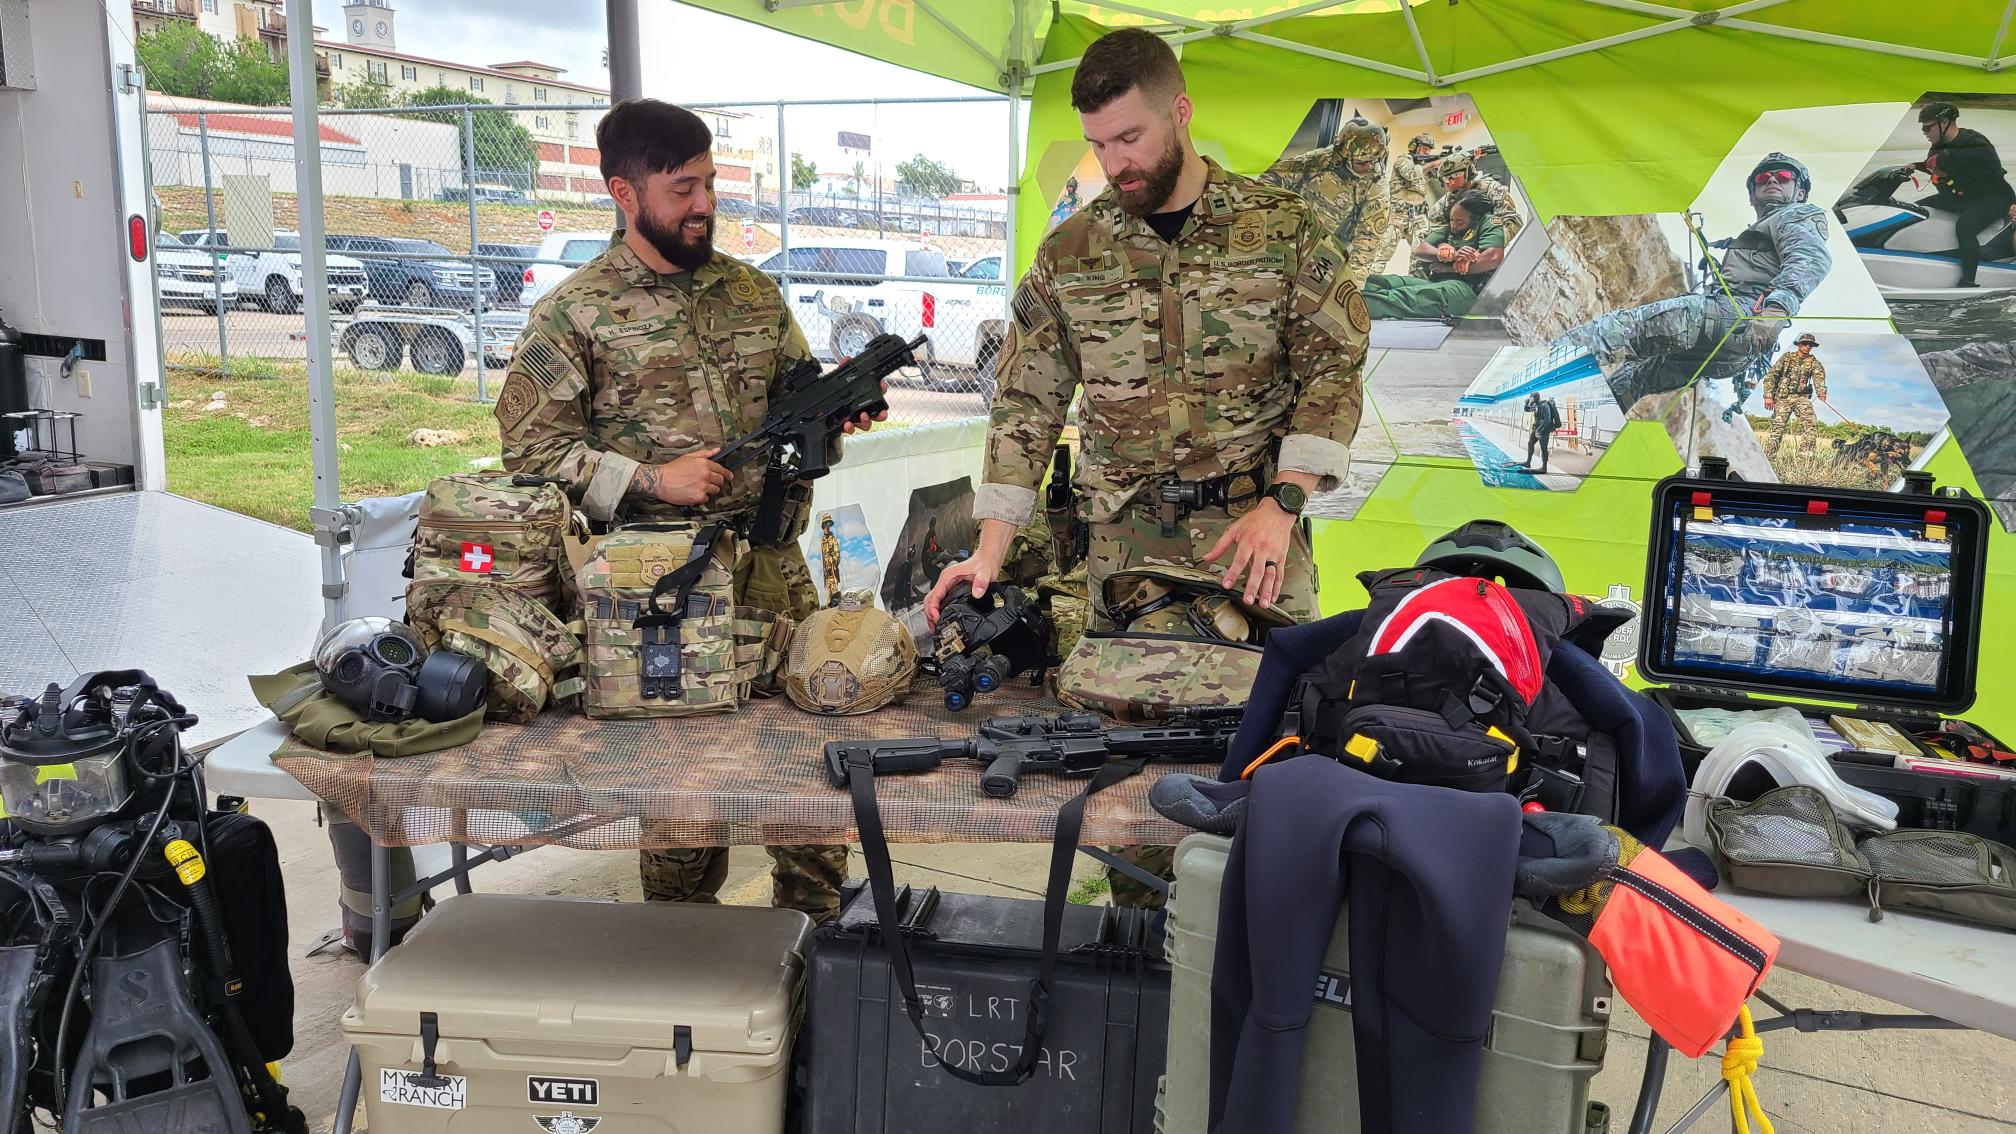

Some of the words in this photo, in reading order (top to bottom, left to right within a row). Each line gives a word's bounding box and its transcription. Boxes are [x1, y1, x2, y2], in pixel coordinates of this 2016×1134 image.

[1227, 258, 1255, 267] BORDER
[976, 286, 1007, 297] BORD
[619, 323, 654, 333] ESPINOZA
[970, 994, 1021, 1021] LRT
[384, 1070, 464, 1093] MYRY
[532, 1081, 592, 1101] YETI
[399, 1087, 464, 1108] RANCH
